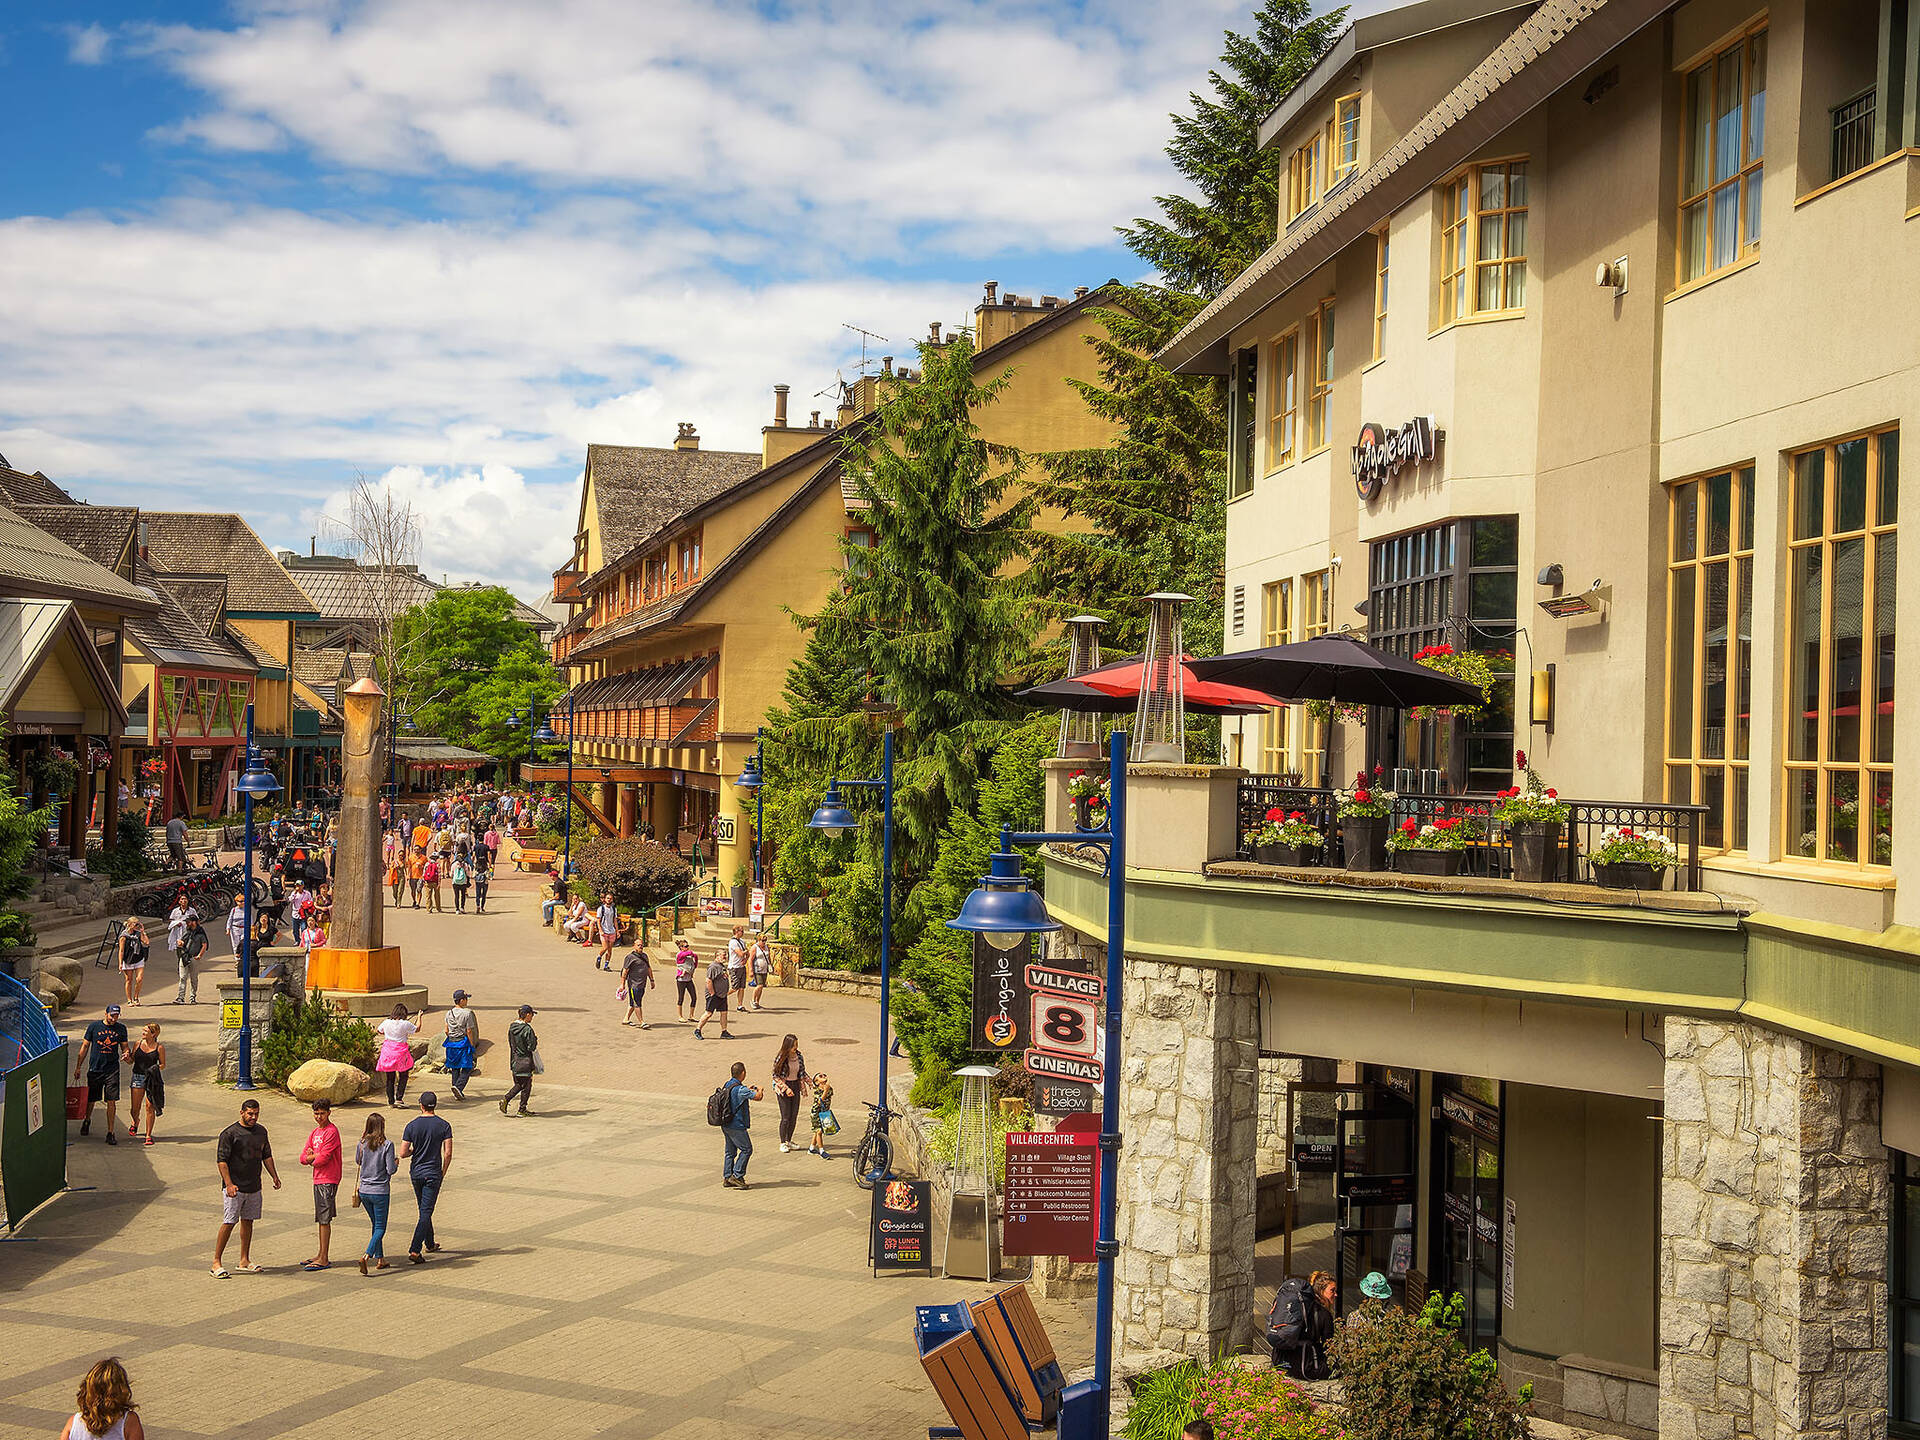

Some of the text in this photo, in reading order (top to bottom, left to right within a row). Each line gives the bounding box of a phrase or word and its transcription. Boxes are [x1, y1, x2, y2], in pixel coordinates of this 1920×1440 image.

[1031, 970, 1098, 995] VILLAGE
[991, 957, 1016, 1041] Mongolie
[1042, 1005, 1085, 1045] 8
[1029, 1056, 1100, 1079] CINEMAS
[1051, 1086, 1081, 1097] three
[1051, 1096, 1087, 1108] below
[1010, 1134, 1075, 1145] VILLAGE CENTRE
[1310, 1144, 1333, 1152] OPEN
[1057, 1154, 1076, 1162] Village
[1052, 1166, 1071, 1174] Village
[884, 1252, 898, 1260] OPEN
